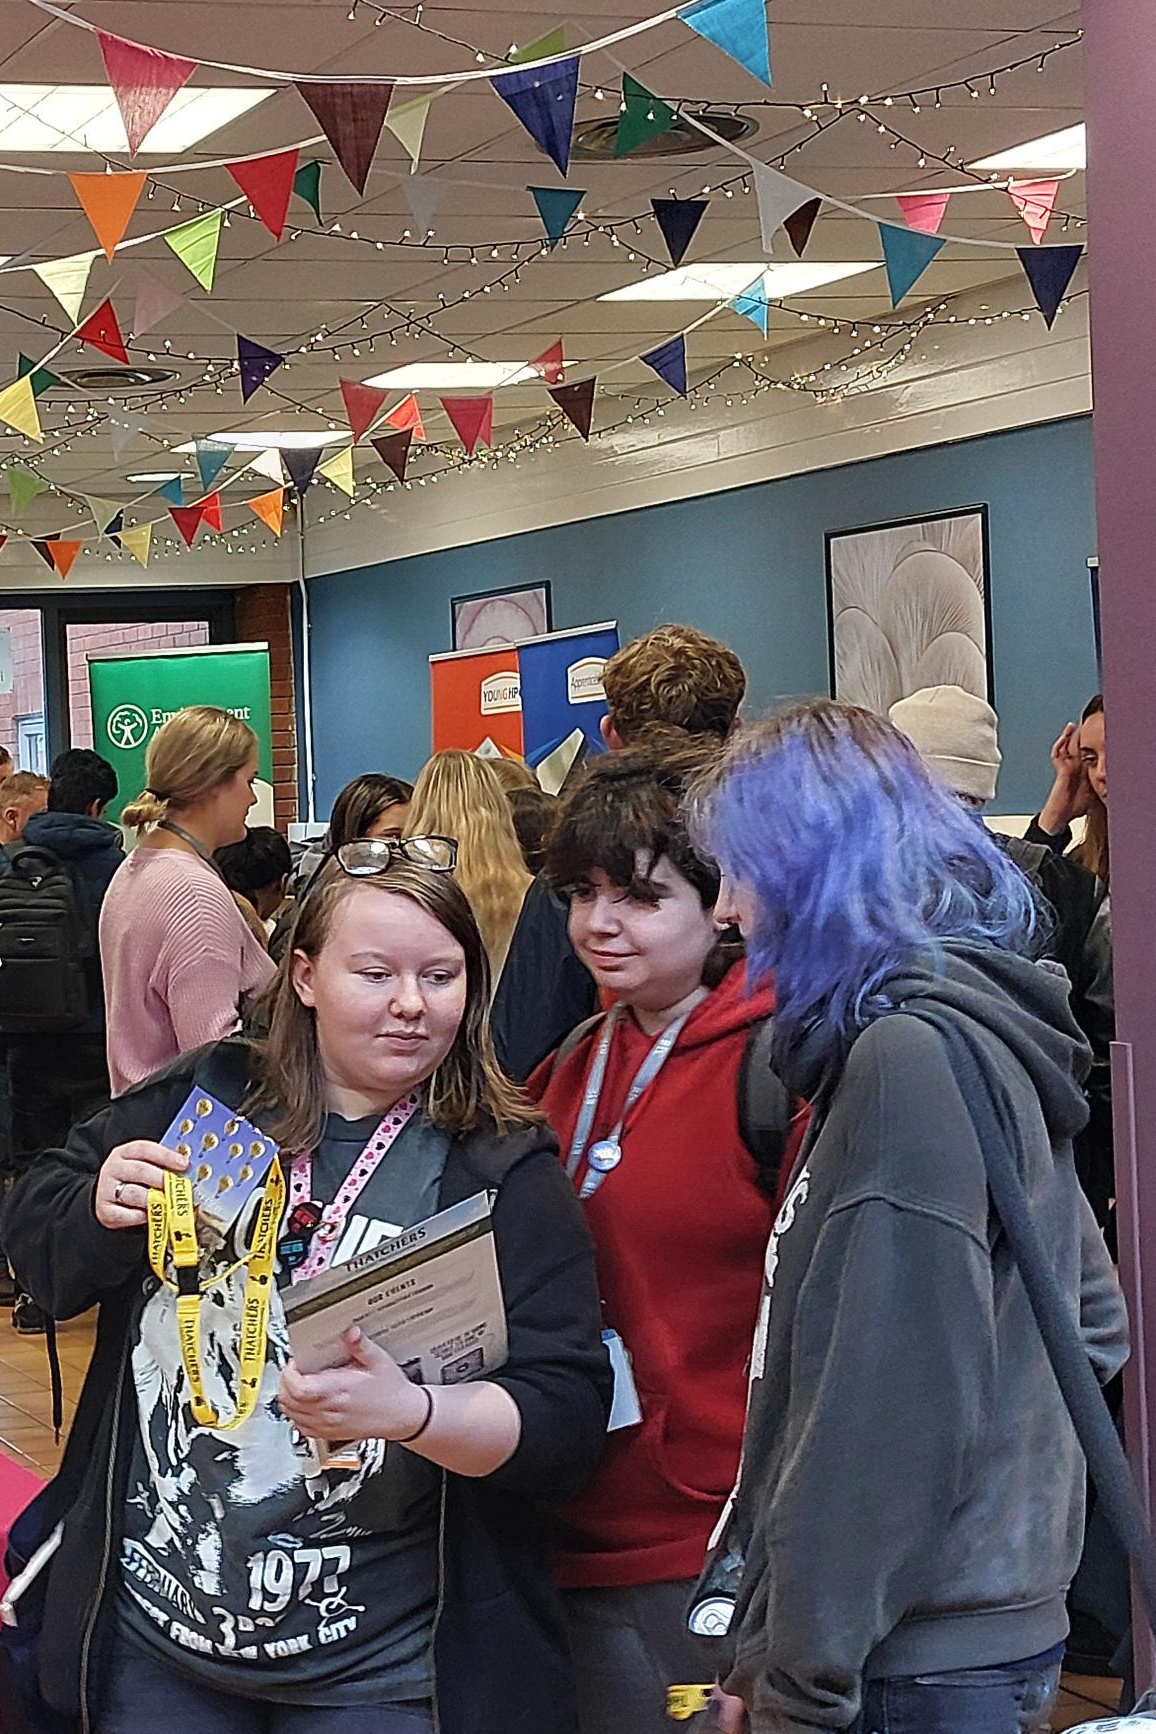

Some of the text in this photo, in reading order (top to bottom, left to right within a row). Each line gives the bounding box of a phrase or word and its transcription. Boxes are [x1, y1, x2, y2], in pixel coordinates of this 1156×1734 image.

[344, 1227, 428, 1273] THATCHERS
[243, 1297, 260, 1362] THATCHERS
[246, 1545, 351, 1612] 1977
[169, 1621, 214, 1656] FROM
[262, 1633, 312, 1660] YORK
[318, 1615, 358, 1645] CITY
